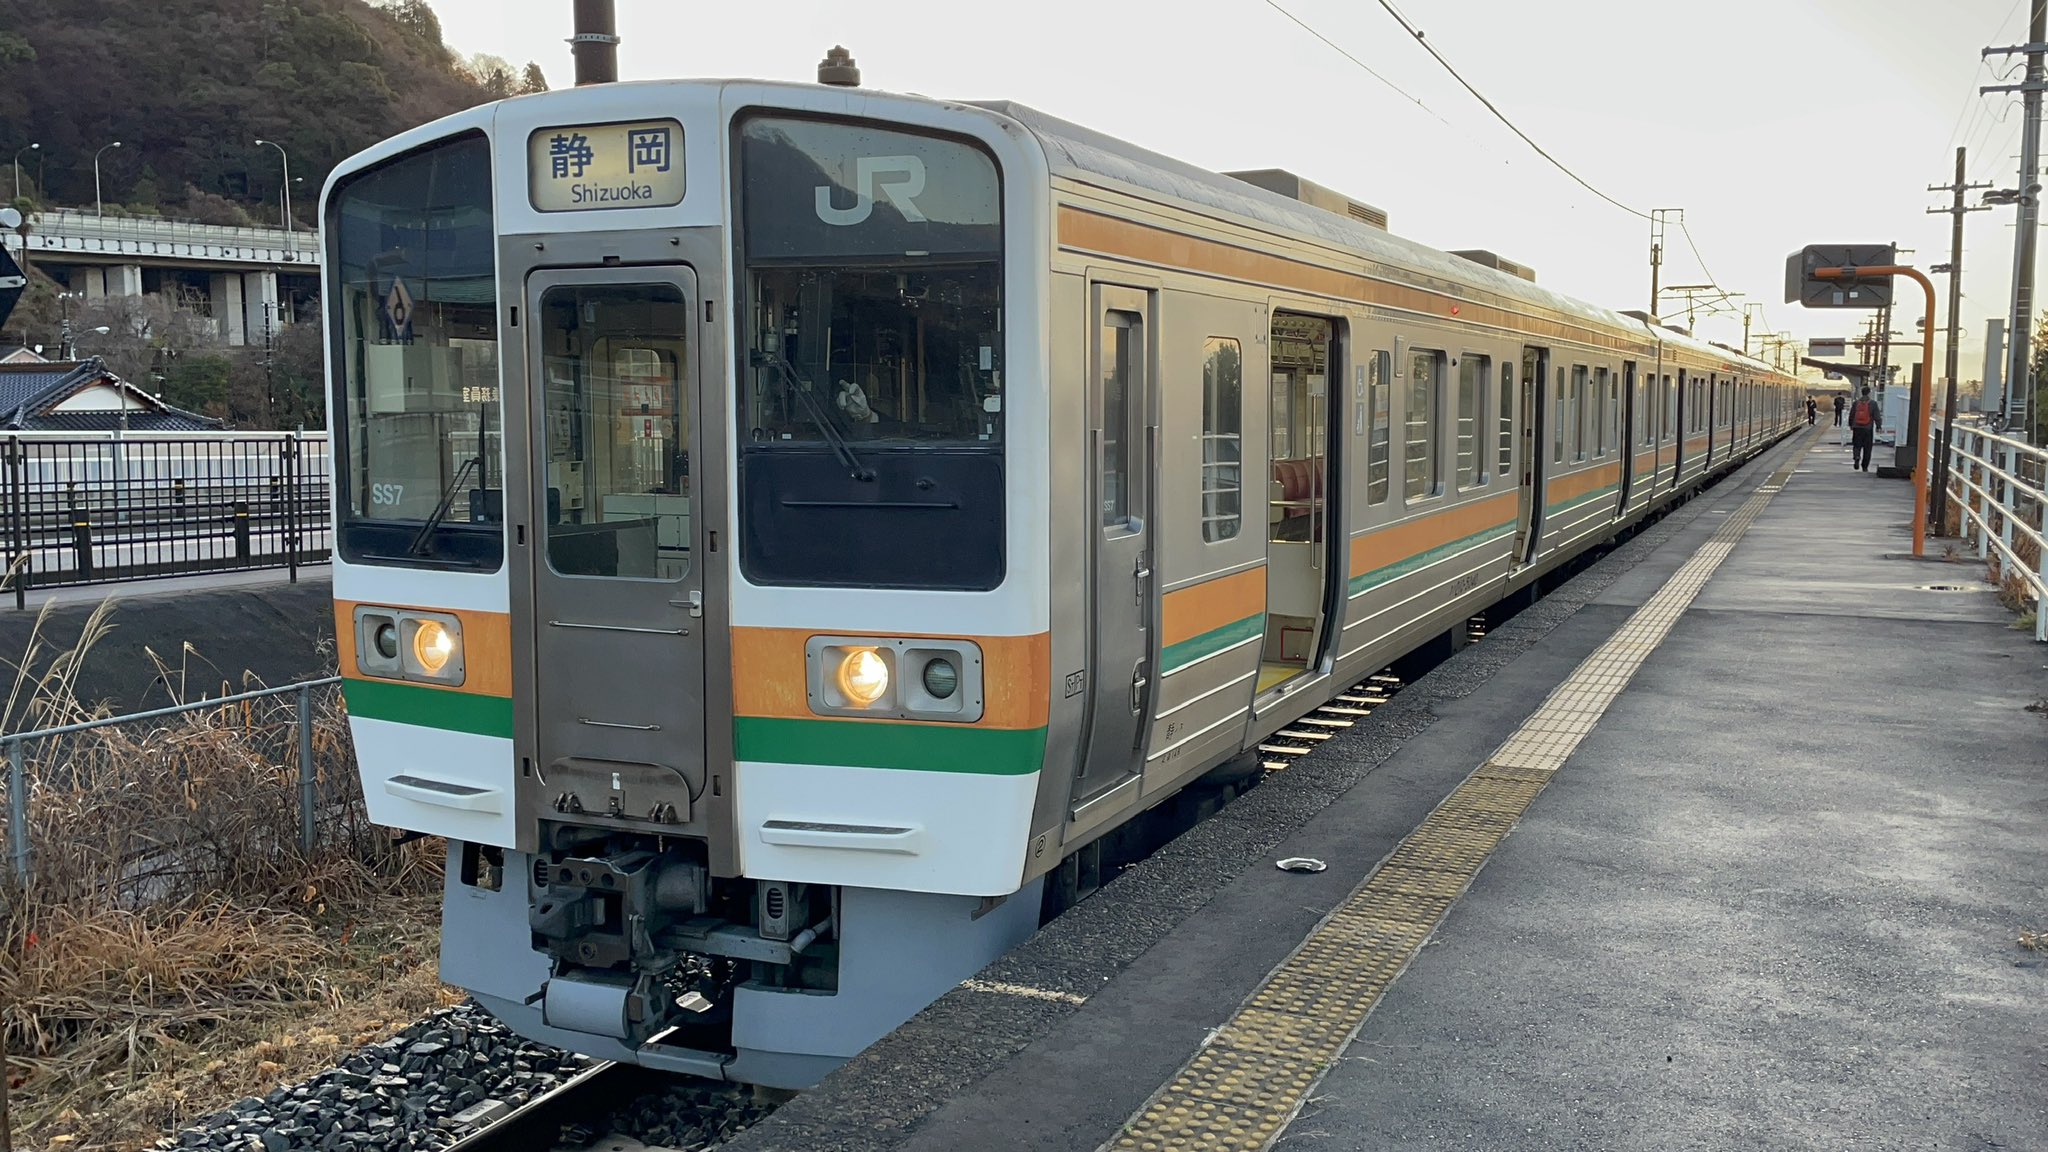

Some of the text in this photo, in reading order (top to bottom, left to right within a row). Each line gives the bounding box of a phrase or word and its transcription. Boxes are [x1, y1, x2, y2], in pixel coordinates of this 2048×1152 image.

[550, 128, 670, 179] 静岡
[571, 180, 653, 203] Shizuoka
[815, 155, 927, 226] JR
[372, 483, 403, 505] SS7
